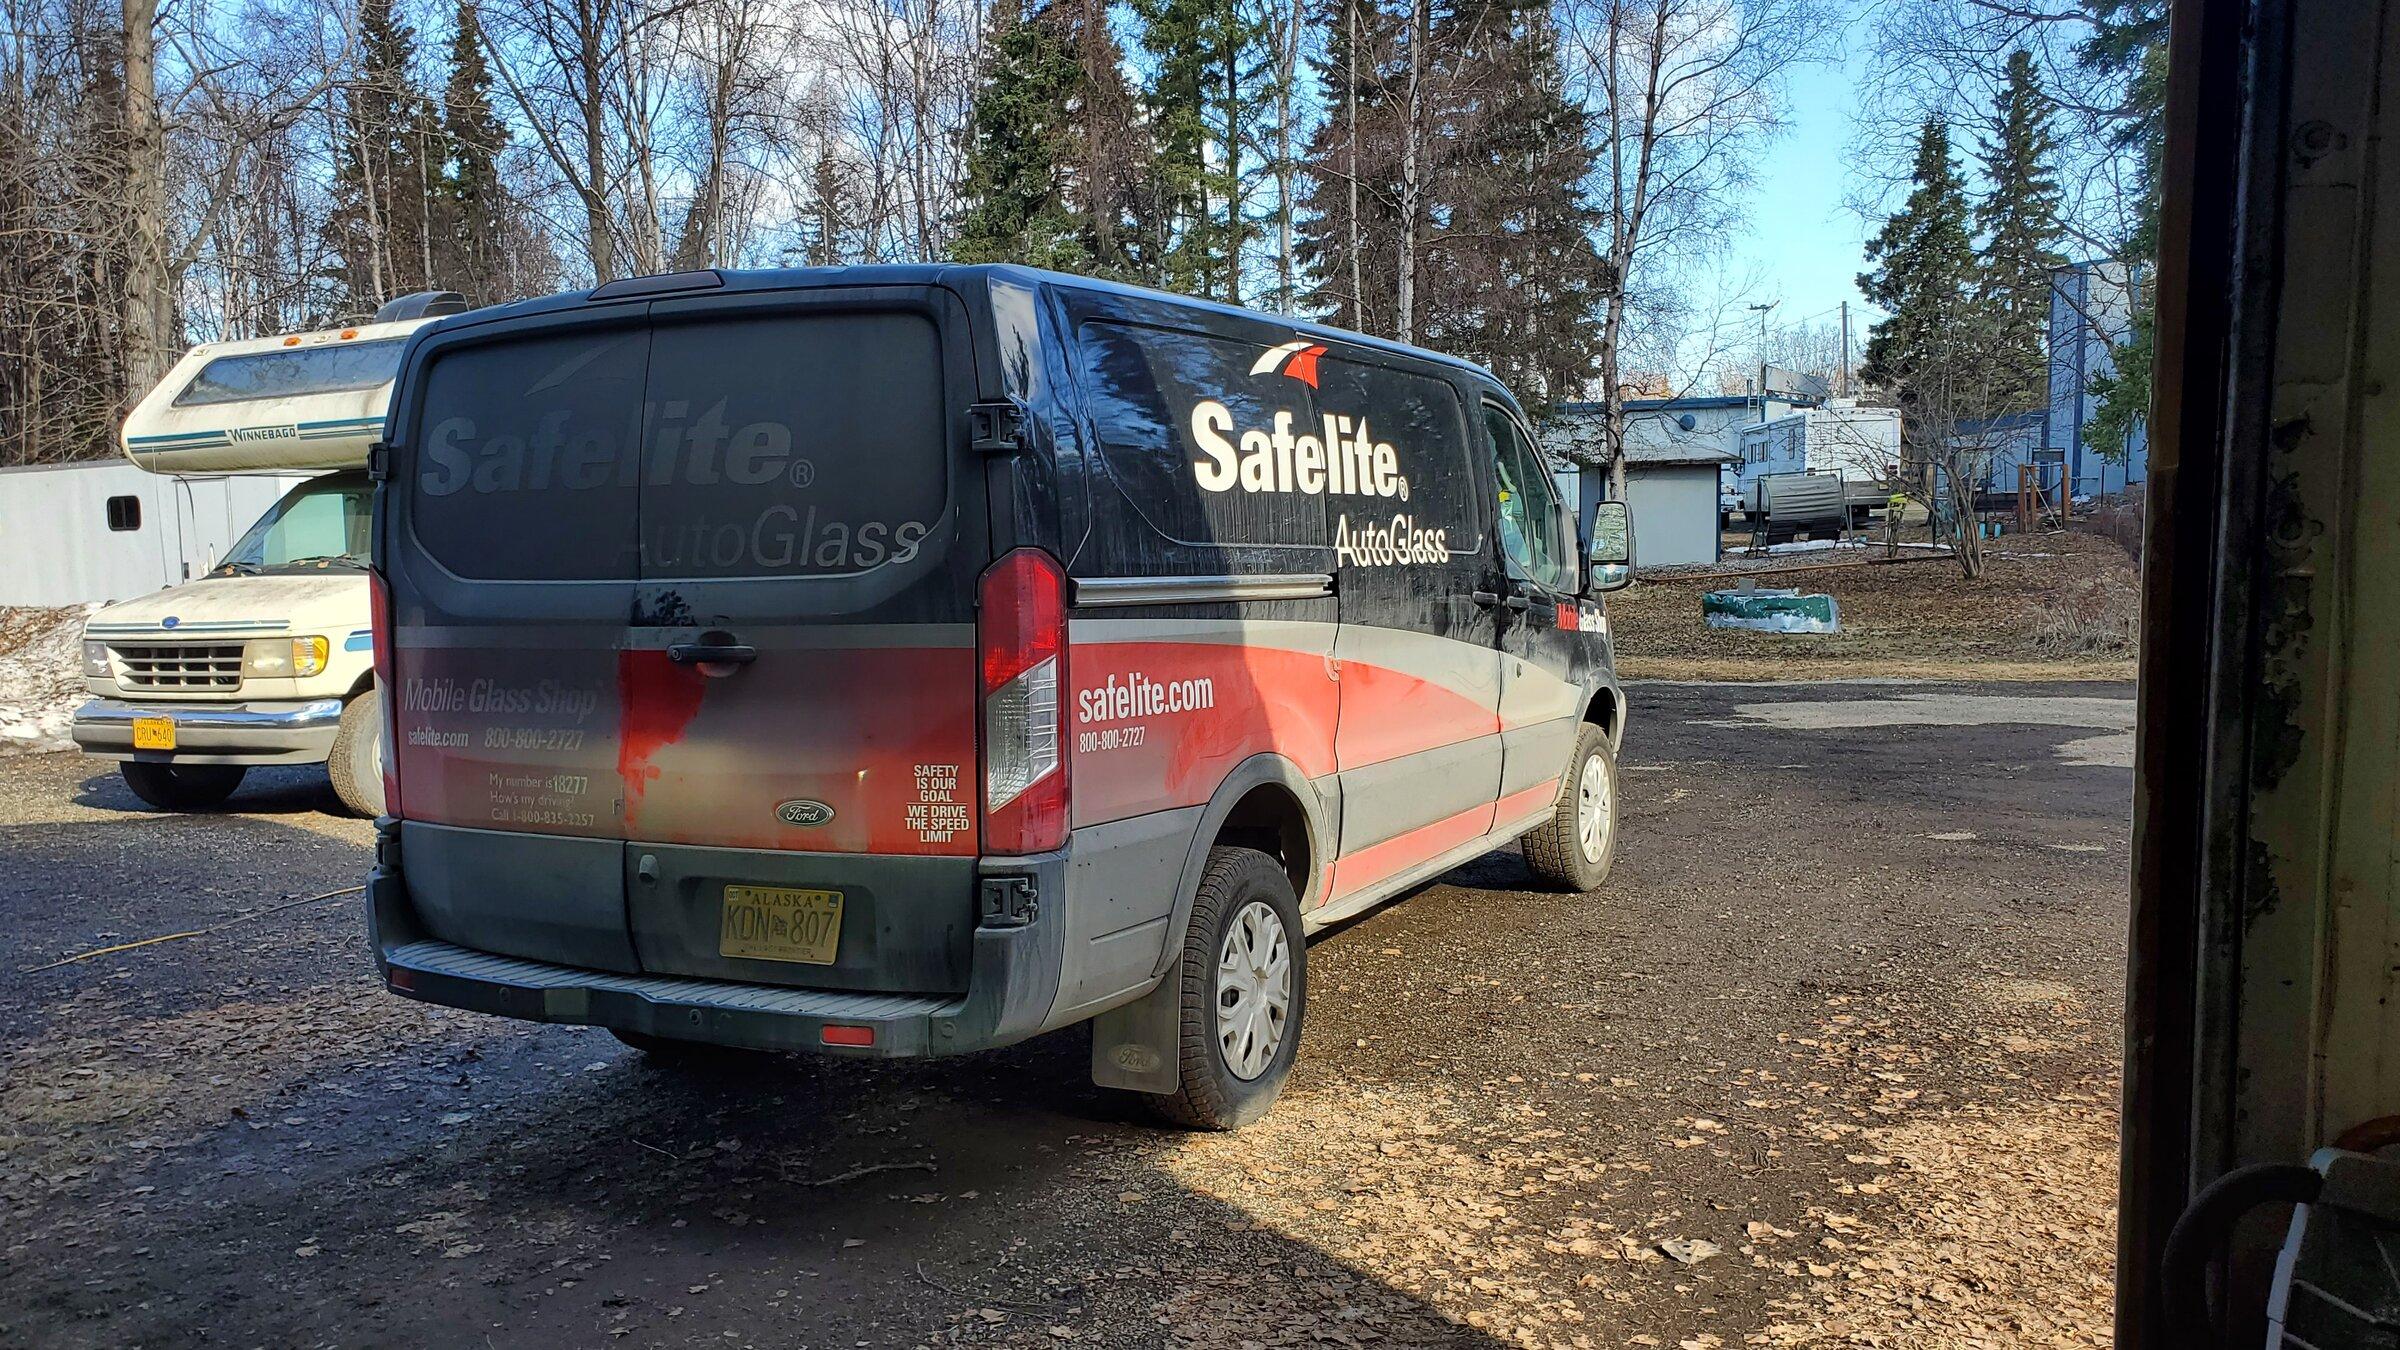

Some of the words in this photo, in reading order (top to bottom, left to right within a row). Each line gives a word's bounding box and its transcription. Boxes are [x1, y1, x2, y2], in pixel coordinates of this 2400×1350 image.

[228, 424, 296, 442] WINNEBAGO
[611, 503, 925, 569] AutoGlass
[1335, 514, 1449, 568] AutoGlass
[404, 678, 466, 712] Mobile
[469, 678, 533, 713] Glass
[535, 680, 598, 724] Shop
[1079, 672, 1214, 723] safelite.com
[408, 726, 469, 748] safelite.com
[484, 727, 585, 751] 800-800-2727
[1079, 726, 1145, 753] 800-800-2727
[913, 765, 959, 778] SAFETY
[489, 773, 503, 788] My
[505, 776, 541, 789] number
[545, 776, 553, 789] is
[552, 775, 588, 795] 18277
[916, 777, 929, 790] IS
[931, 777, 957, 790] OUR
[521, 794, 536, 807] my
[920, 790, 954, 803] GOAL
[491, 808, 509, 821] Call
[786, 804, 820, 822] Ford
[907, 805, 929, 818] WE
[930, 805, 967, 819] DRIVE
[904, 818, 928, 830] THE
[930, 818, 970, 831] SPEED
[919, 830, 954, 843] LIMIT
[751, 893, 813, 908] ALASKA
[725, 905, 771, 942] KDN
[790, 909, 835, 948] 807
